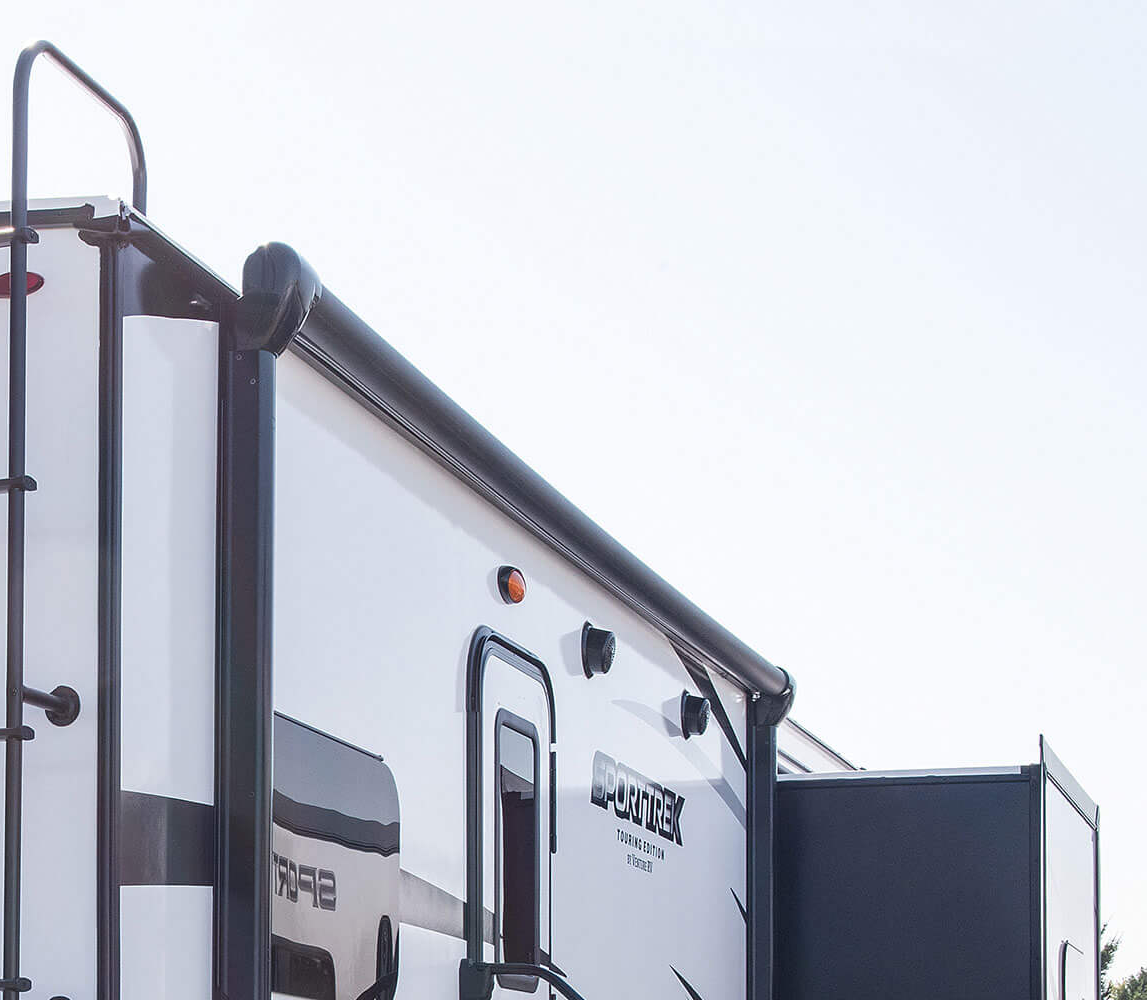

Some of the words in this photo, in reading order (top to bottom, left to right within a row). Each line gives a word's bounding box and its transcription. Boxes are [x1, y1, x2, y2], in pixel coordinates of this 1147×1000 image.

[590, 750, 686, 847] SPORTTREK
[616, 828, 642, 851] TOURING
[643, 840, 665, 861] EDITION
